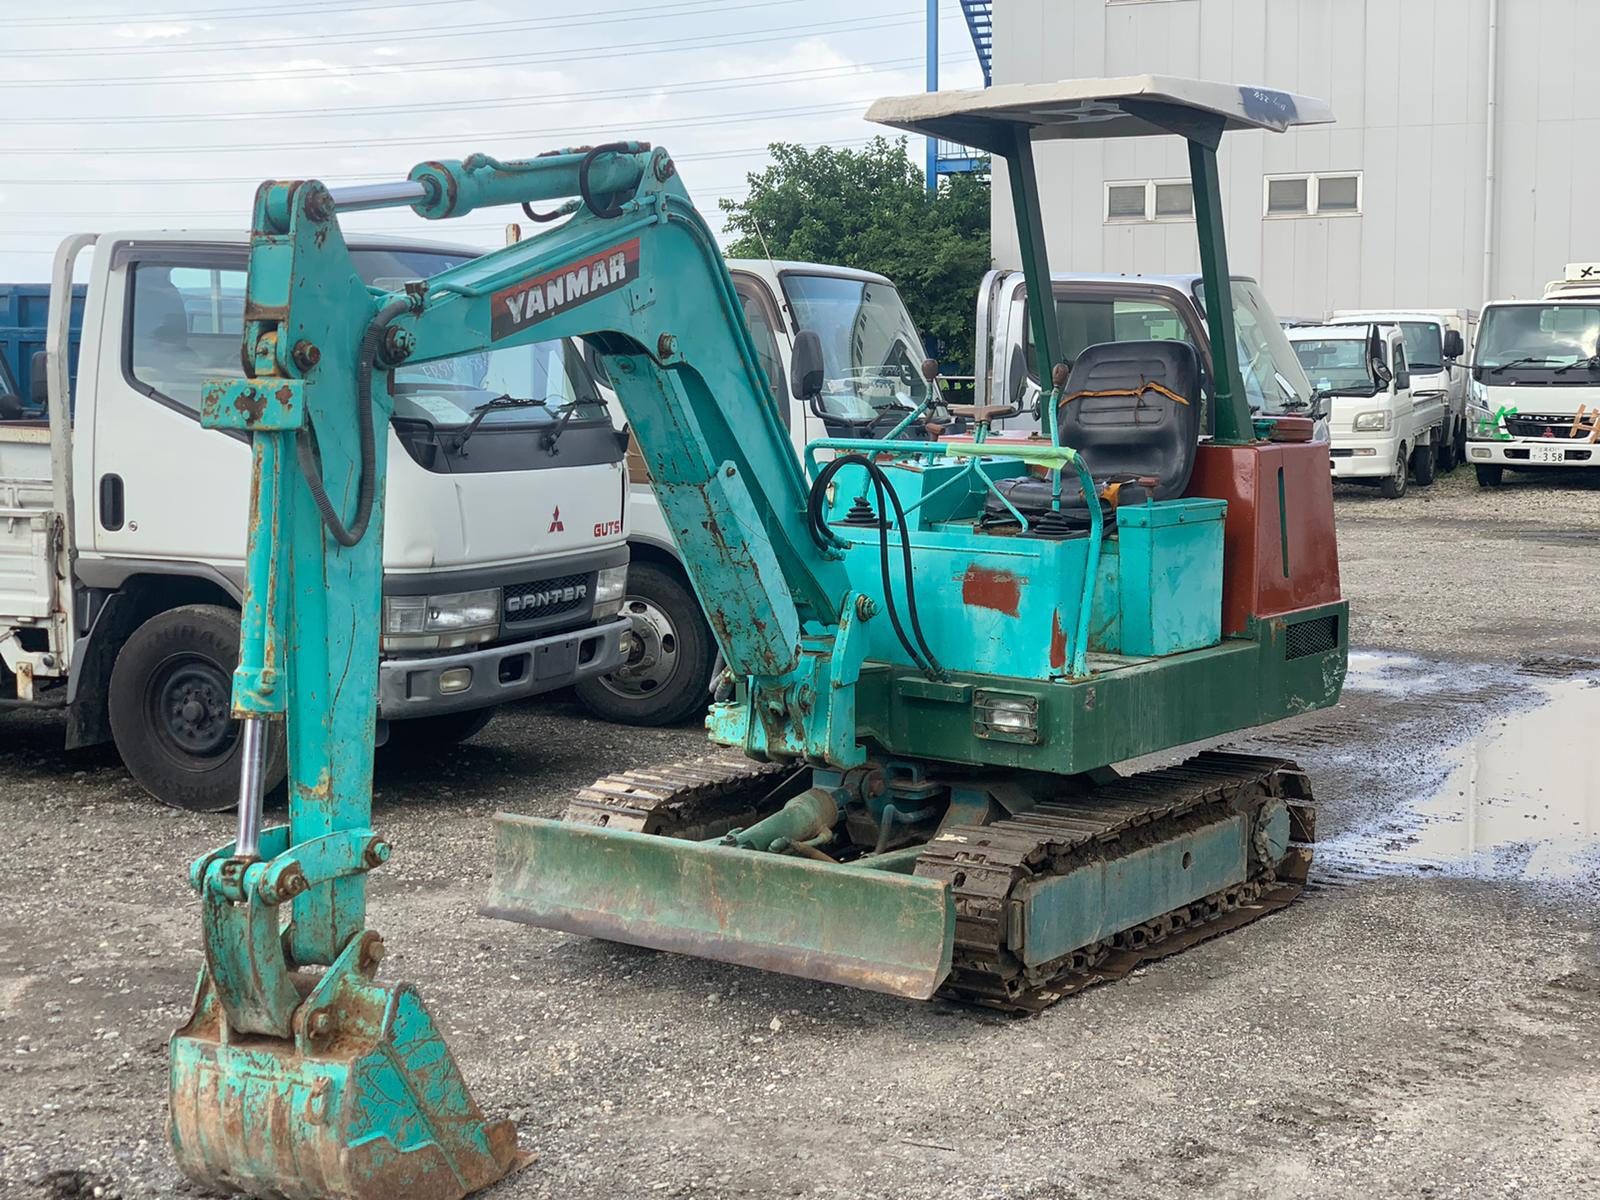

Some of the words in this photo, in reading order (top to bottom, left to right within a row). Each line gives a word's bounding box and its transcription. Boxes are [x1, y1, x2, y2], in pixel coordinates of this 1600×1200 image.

[505, 251, 626, 325] YANMAR
[593, 520, 620, 538] GUTS
[505, 584, 588, 613] CANTER
